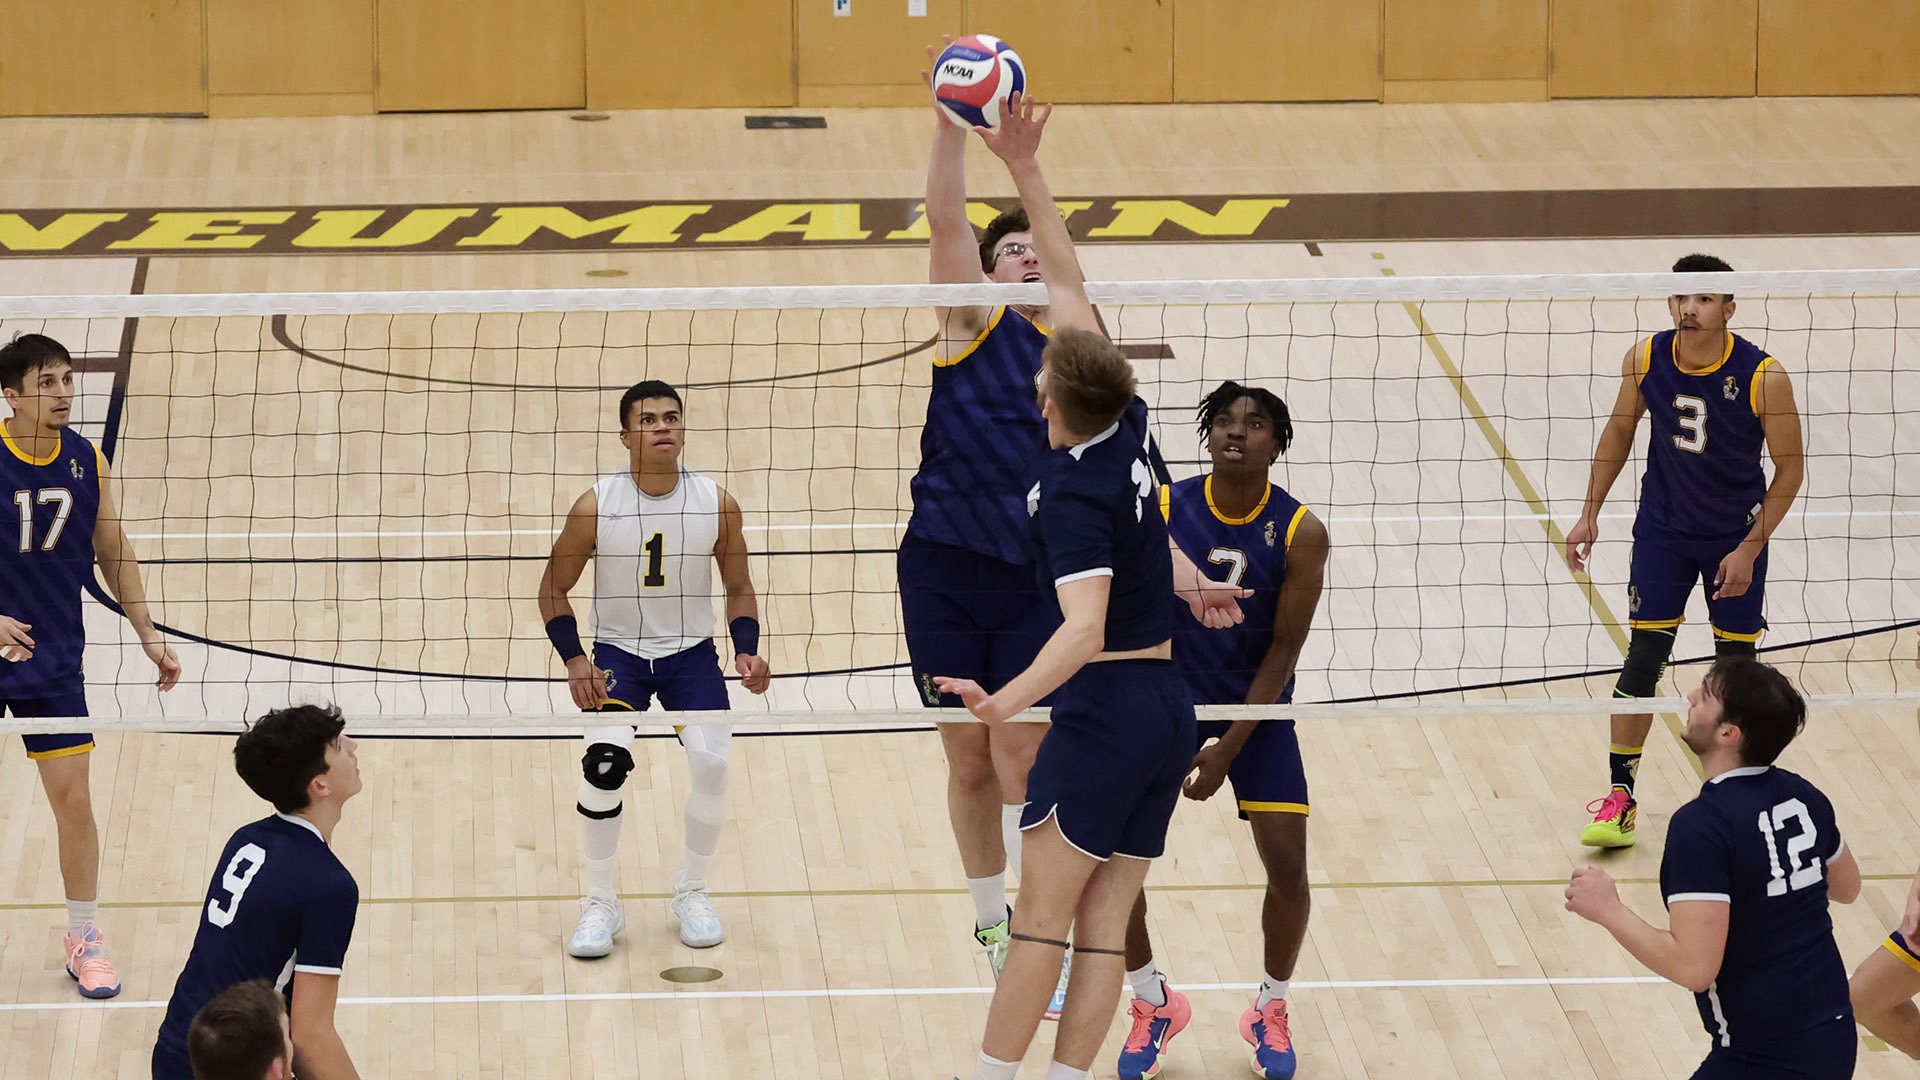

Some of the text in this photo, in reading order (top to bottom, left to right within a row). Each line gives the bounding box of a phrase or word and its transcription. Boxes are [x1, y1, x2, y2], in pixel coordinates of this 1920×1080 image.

[1672, 394, 1708, 454] 3
[14, 487, 73, 552] 17
[642, 531, 666, 588] 1
[1758, 798, 1824, 896] 12
[207, 842, 266, 929] 9
